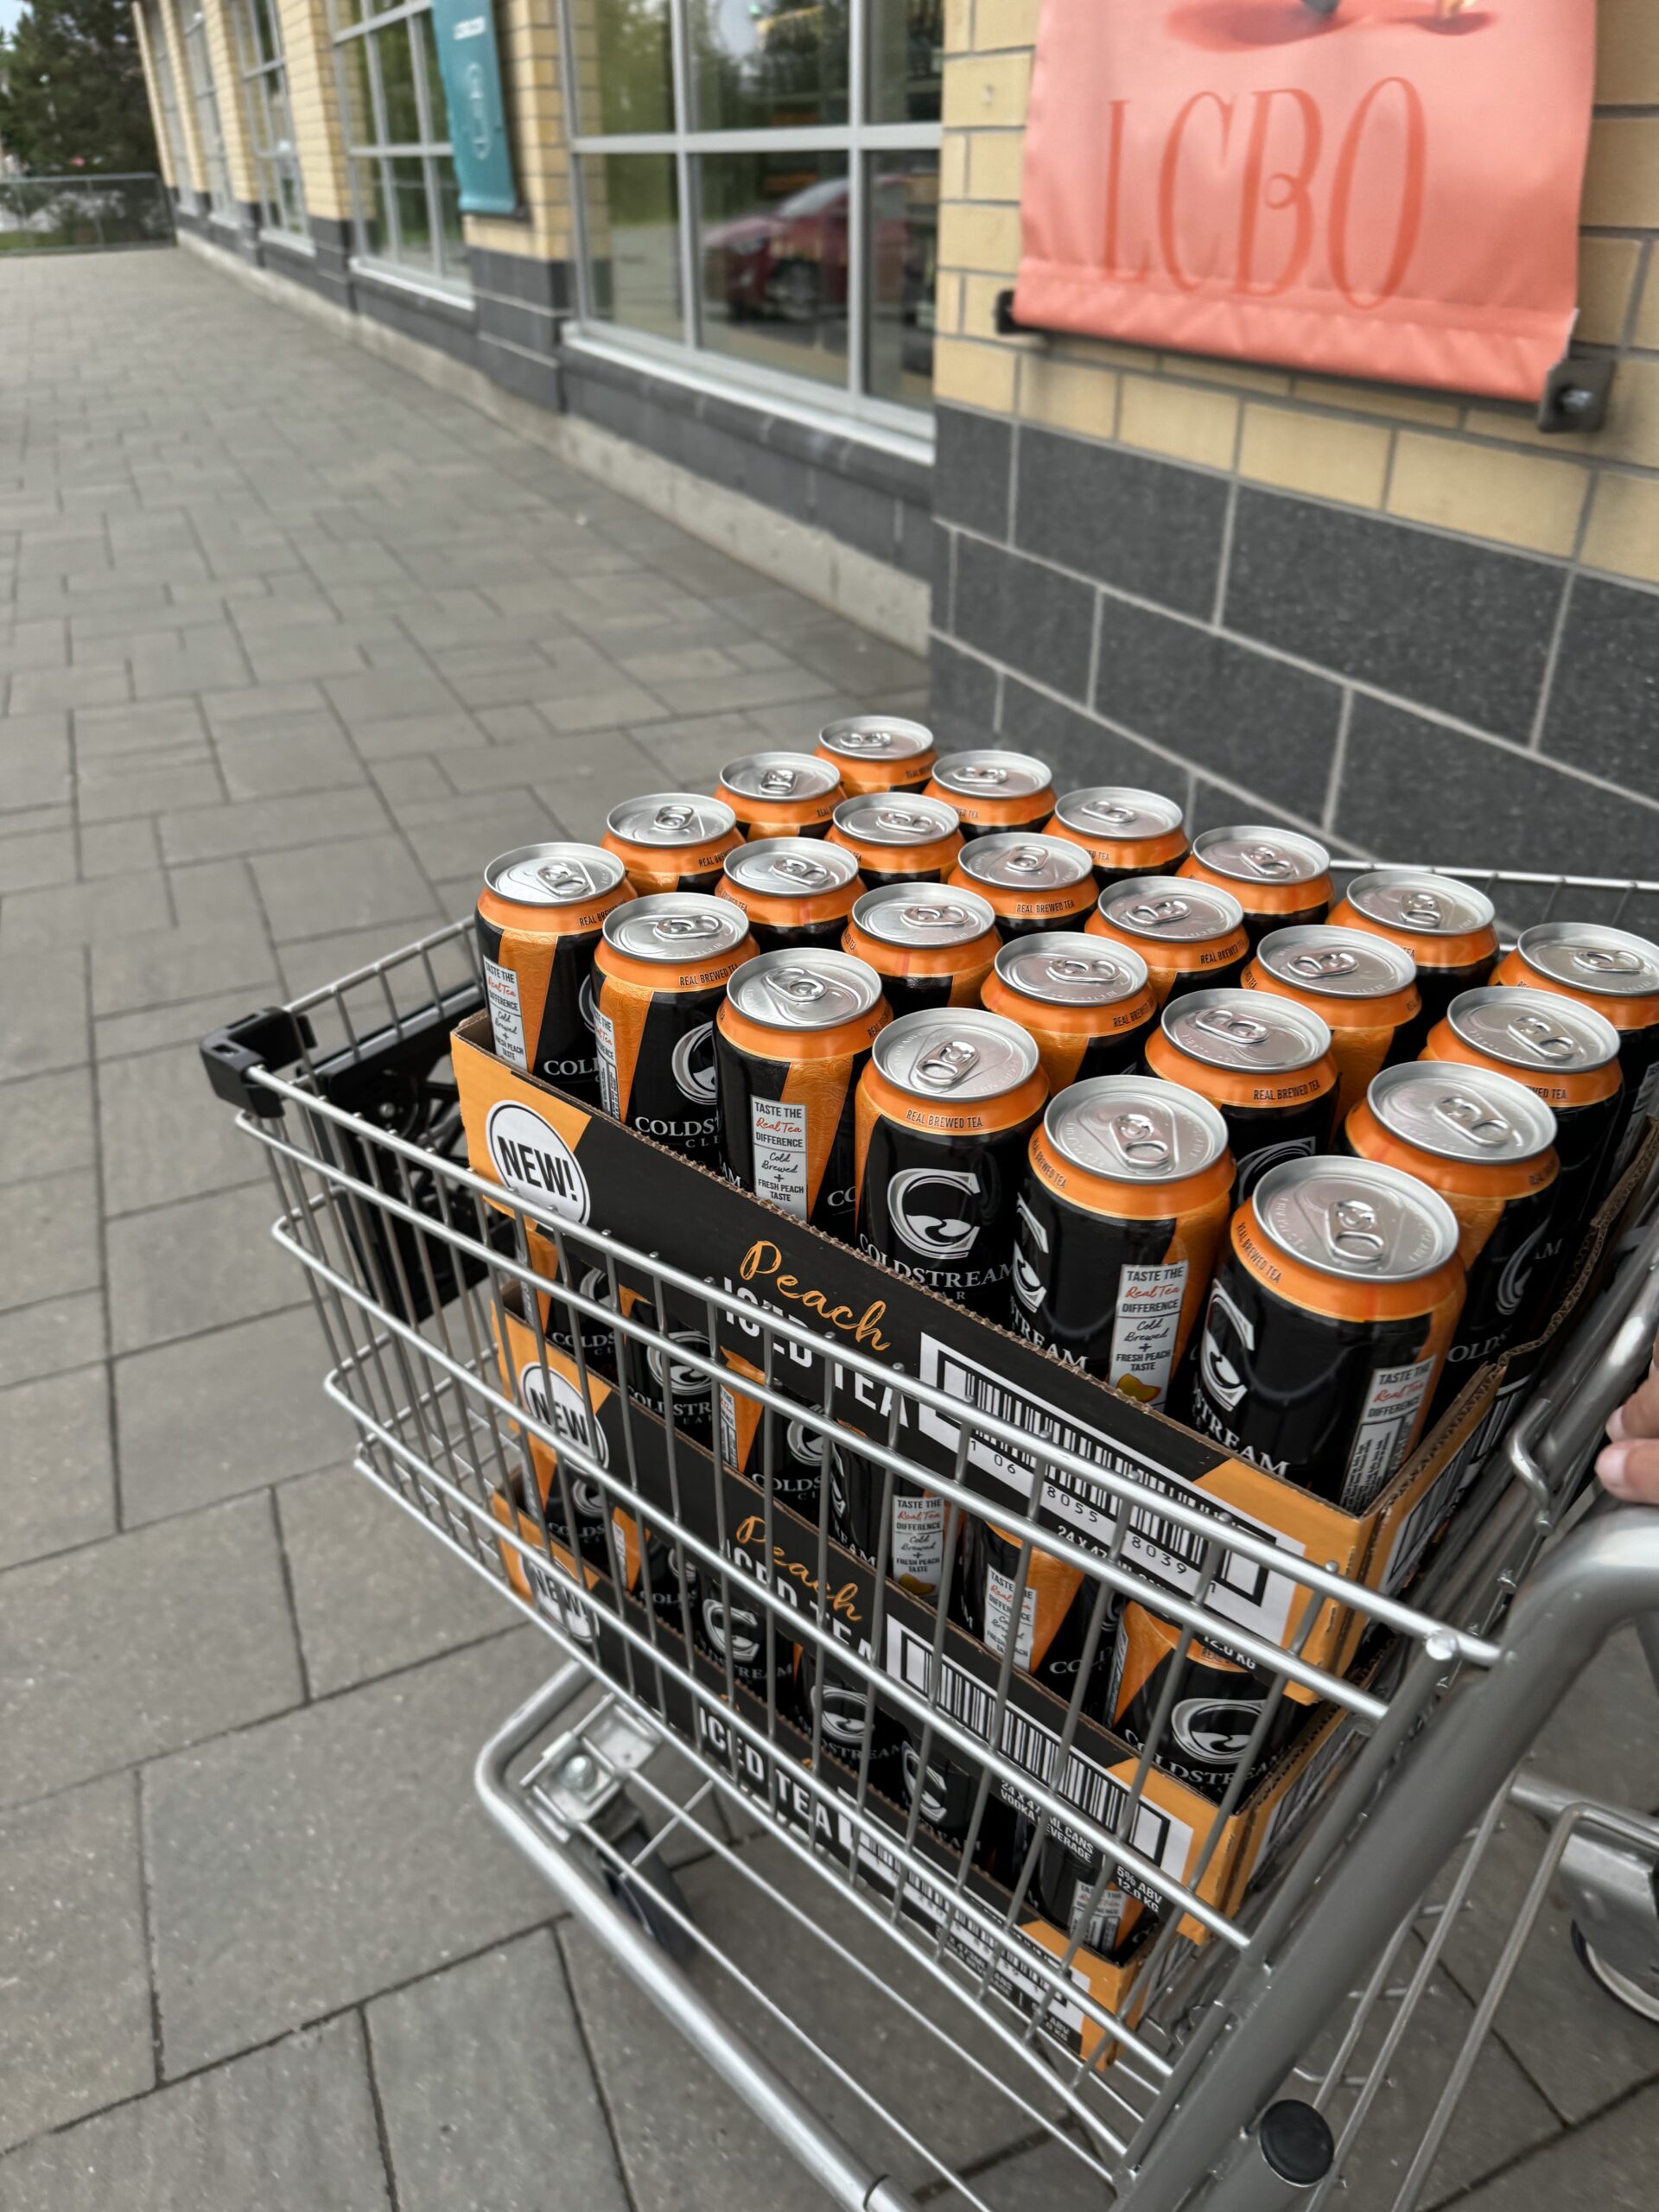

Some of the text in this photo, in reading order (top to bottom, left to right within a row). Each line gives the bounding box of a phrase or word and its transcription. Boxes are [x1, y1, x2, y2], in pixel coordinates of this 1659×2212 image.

[1103, 76, 1427, 311] LCBO
[1016, 899, 1076, 913] REAL BREWED TEA
[579, 914, 596, 927] REAL
[1200, 953, 1217, 965] REAL
[502, 969, 516, 984] THE
[679, 976, 698, 986] REAL
[700, 968, 728, 983] BREWED
[1253, 1079, 1320, 1101] REAL BREWED TEA
[1551, 1088, 1567, 1100] TEA
[754, 1102, 803, 1119] TASTE THE
[906, 1109, 982, 1128] REAL BREWED TEA
[635, 1116, 721, 1137] COLDS
[756, 1116, 803, 1134] Real Tea
[685, 1135, 721, 1149] CLE
[755, 1131, 804, 1148] DIFFERENCE
[769, 1152, 791, 1163] Cold
[498, 1135, 578, 1202] NEW!
[761, 1160, 798, 1173] Brewed
[758, 1179, 804, 1194] FRESH PEACH
[1054, 1173, 1068, 1189] TEA
[770, 1191, 791, 1202] TASTE
[860, 1233, 1014, 1288] COLDSTREAM
[1127, 1266, 1185, 1282] TASTE THE
[1266, 1264, 1283, 1283] TEA
[740, 1240, 892, 1351] Peach
[1126, 1282, 1180, 1298] Real Tea
[1122, 1299, 1179, 1313] DIFFERENCE
[1136, 1320, 1162, 1332] Cold
[1012, 1298, 1090, 1371] TREAM
[1124, 1330, 1168, 1343] Brewed
[1116, 1349, 1172, 1362] FRESH PEACH
[1130, 1362, 1156, 1372] TASTE
[1379, 1370, 1413, 1385] TASTE
[530, 1386, 590, 1447] NEW
[1196, 1389, 1291, 1479] TREAM
[897, 1497, 943, 1510] TASTE THE
[896, 1521, 942, 1532] DIFFERENCE
[1046, 1485, 1099, 1524] 8055
[1131, 1536, 1188, 1575] 8039
[909, 1535, 930, 1545] Cold
[735, 1515, 863, 1622] Peach
[896, 1556, 940, 1566] FRESH PEACH
[907, 1565, 929, 1573] TASTE
[990, 1571, 1014, 1592] TASTE
[1236, 1651, 1256, 1670] KG
[775, 1768, 833, 1838] TEA
[1001, 1788, 1092, 1863] VODKA EVERAGE
[1065, 1826, 1095, 1855] CANS
[1116, 1865, 1163, 1904] 5% ABV
[1117, 1877, 1160, 1913] 12.0 KG
